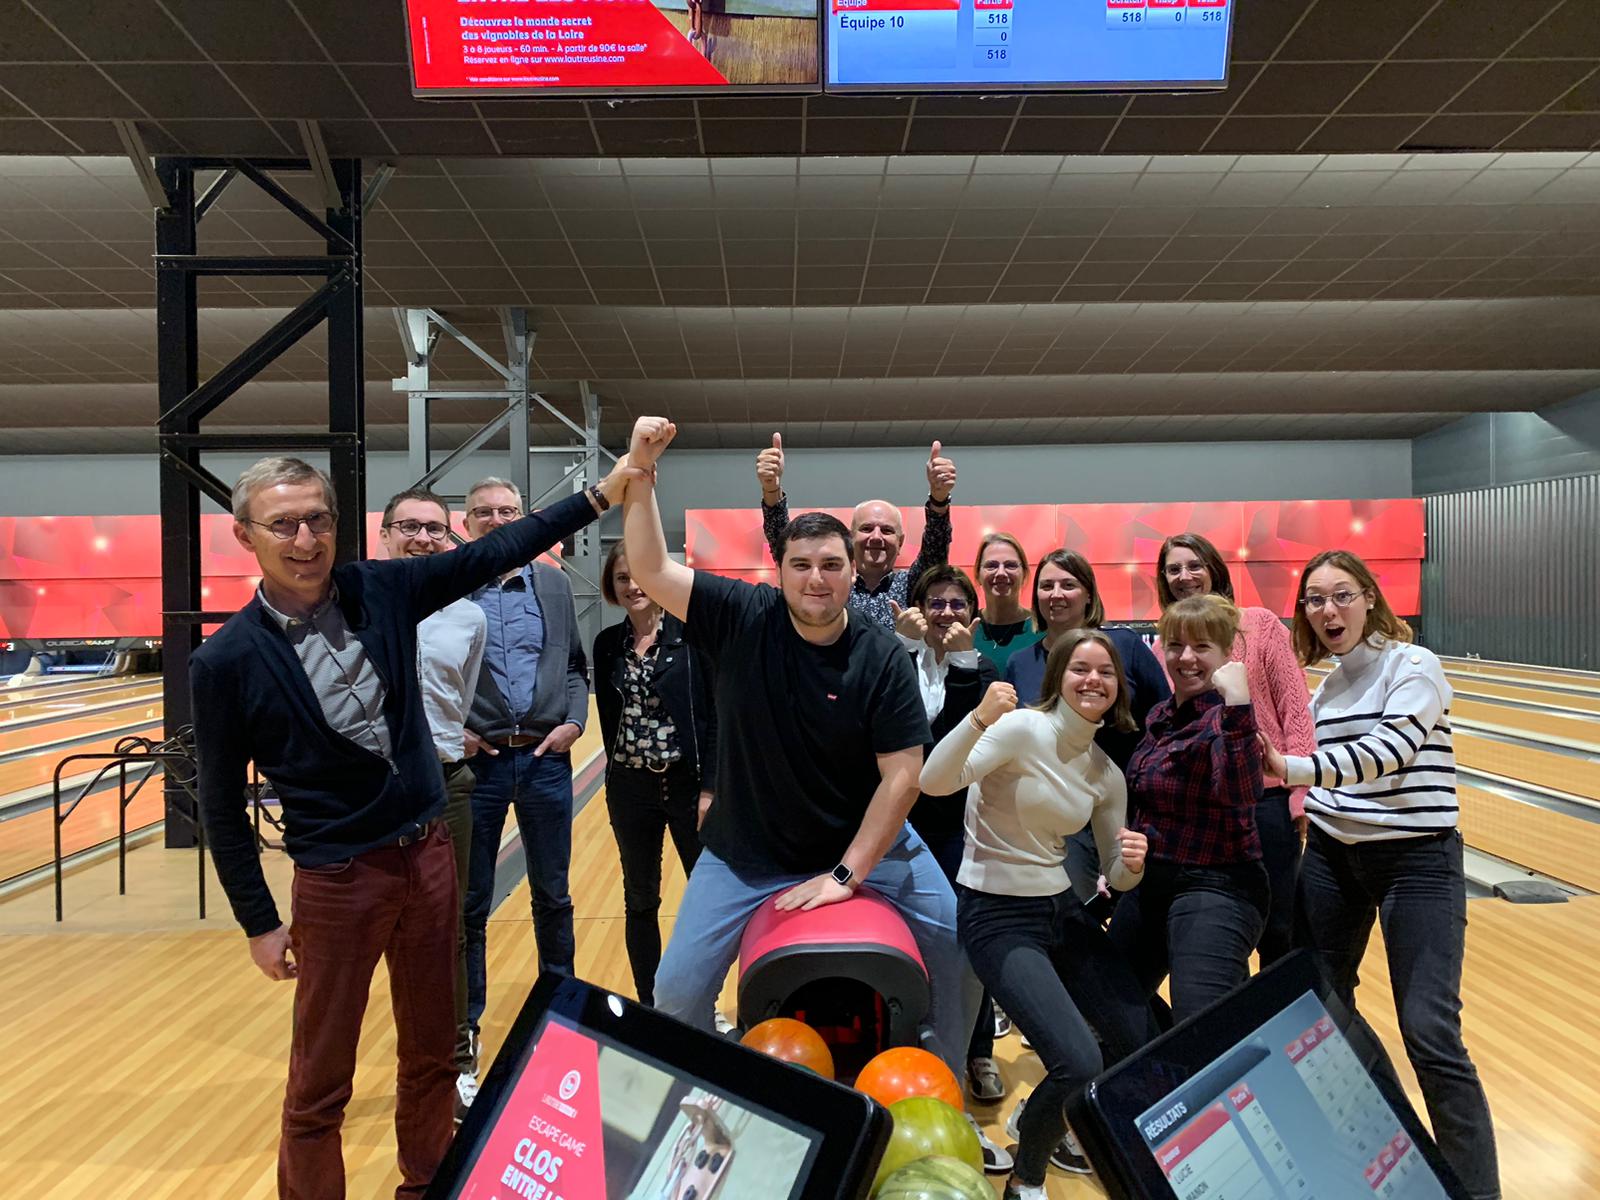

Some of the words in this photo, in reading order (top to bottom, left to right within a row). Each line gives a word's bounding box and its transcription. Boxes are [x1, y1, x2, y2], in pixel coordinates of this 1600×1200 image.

[460, 16, 513, 27] Découvrez
[514, 16, 524, 26] le
[525, 16, 560, 26] monde
[561, 16, 593, 26] secret
[840, 14, 885, 30] Équipe
[890, 16, 904, 28] 10
[988, 13, 1008, 24] 518
[1122, 12, 1142, 22] 518
[1175, 12, 1182, 22] 0
[1202, 11, 1222, 21] 518
[461, 30, 479, 40] des
[481, 29, 530, 42] vignobles
[531, 29, 544, 40] de
[546, 29, 556, 39] la
[558, 29, 584, 39] Loire
[1000, 31, 1007, 41] 0
[463, 45, 468, 53] 3
[477, 45, 483, 53] 8
[484, 45, 513, 54] joueurs
[520, 44, 531, 53] 60
[564, 43, 586, 54] partir
[588, 43, 598, 52] de
[599, 43, 617, 52] 90€
[618, 43, 626, 52] la
[464, 55, 498, 64] Réservez
[499, 56, 508, 64] en
[510, 55, 529, 65] ligne
[987, 49, 1007, 60] 518
[6, 642, 15, 652] 3
[145, 640, 153, 649] 4
[1144, 1101, 1188, 1141] RÉSULTATS
[528, 1114, 562, 1143] ESCAPE
[558, 1132, 587, 1158] GAME
[513, 1137, 564, 1184] CLOS
[500, 1163, 547, 1200] ENTRE
